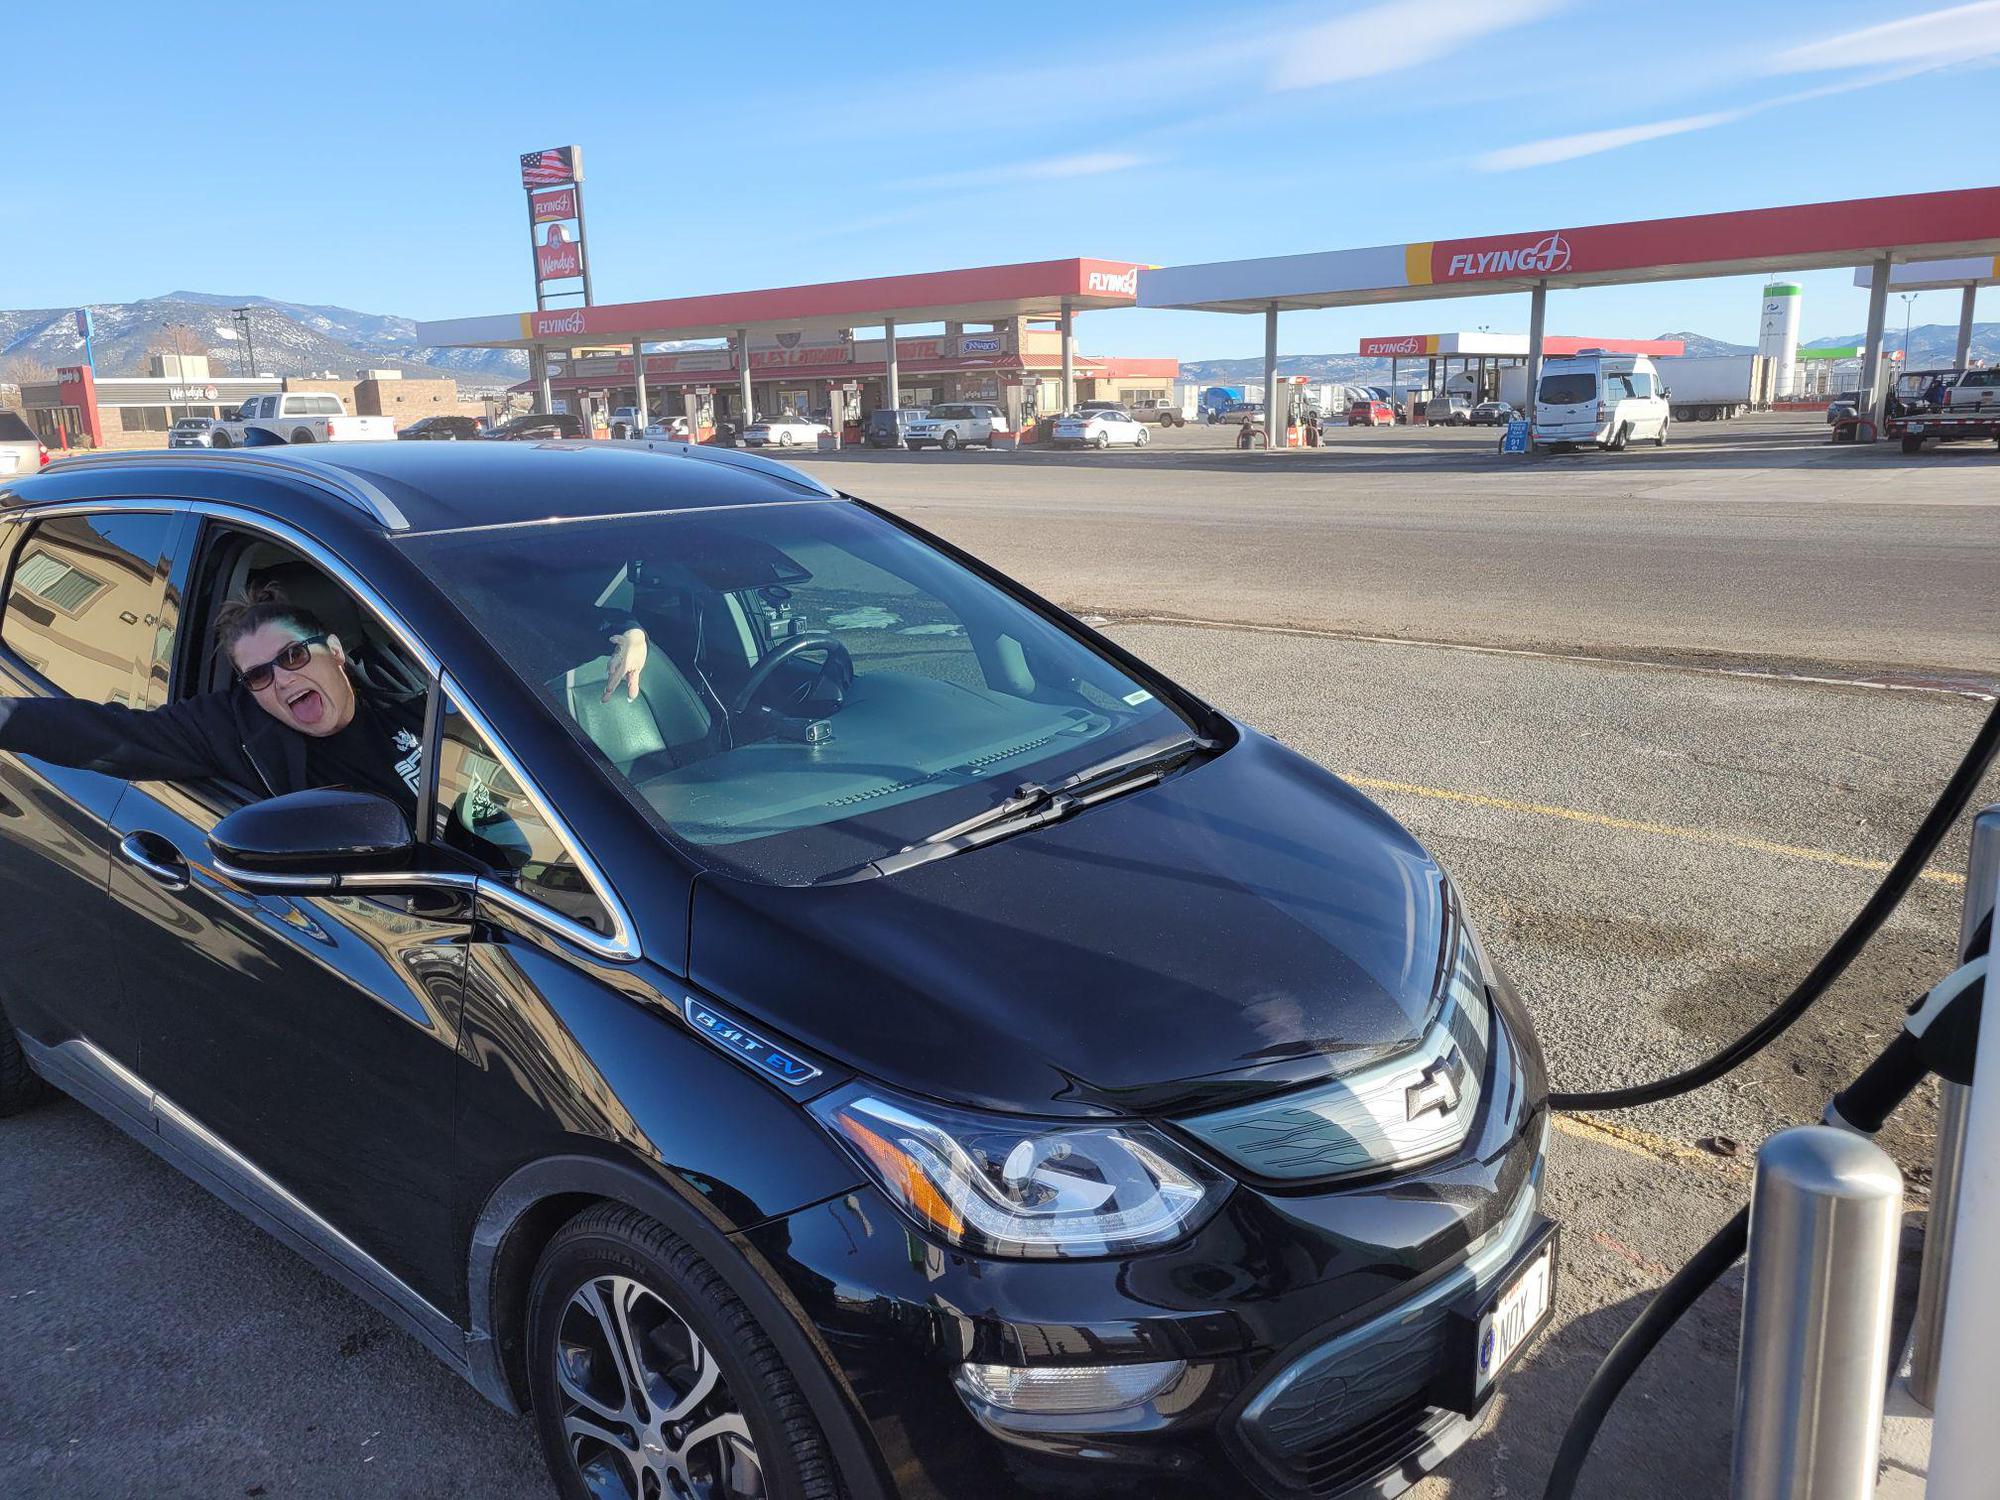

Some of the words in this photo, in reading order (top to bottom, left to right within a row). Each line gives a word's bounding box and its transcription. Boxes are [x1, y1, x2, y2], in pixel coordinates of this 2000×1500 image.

[542, 252, 575, 276] Wendy's
[1448, 247, 1537, 276] FLYING
[538, 317, 573, 334] FLYING
[1367, 343, 1405, 354] FLYING
[765, 1053, 805, 1075] EV
